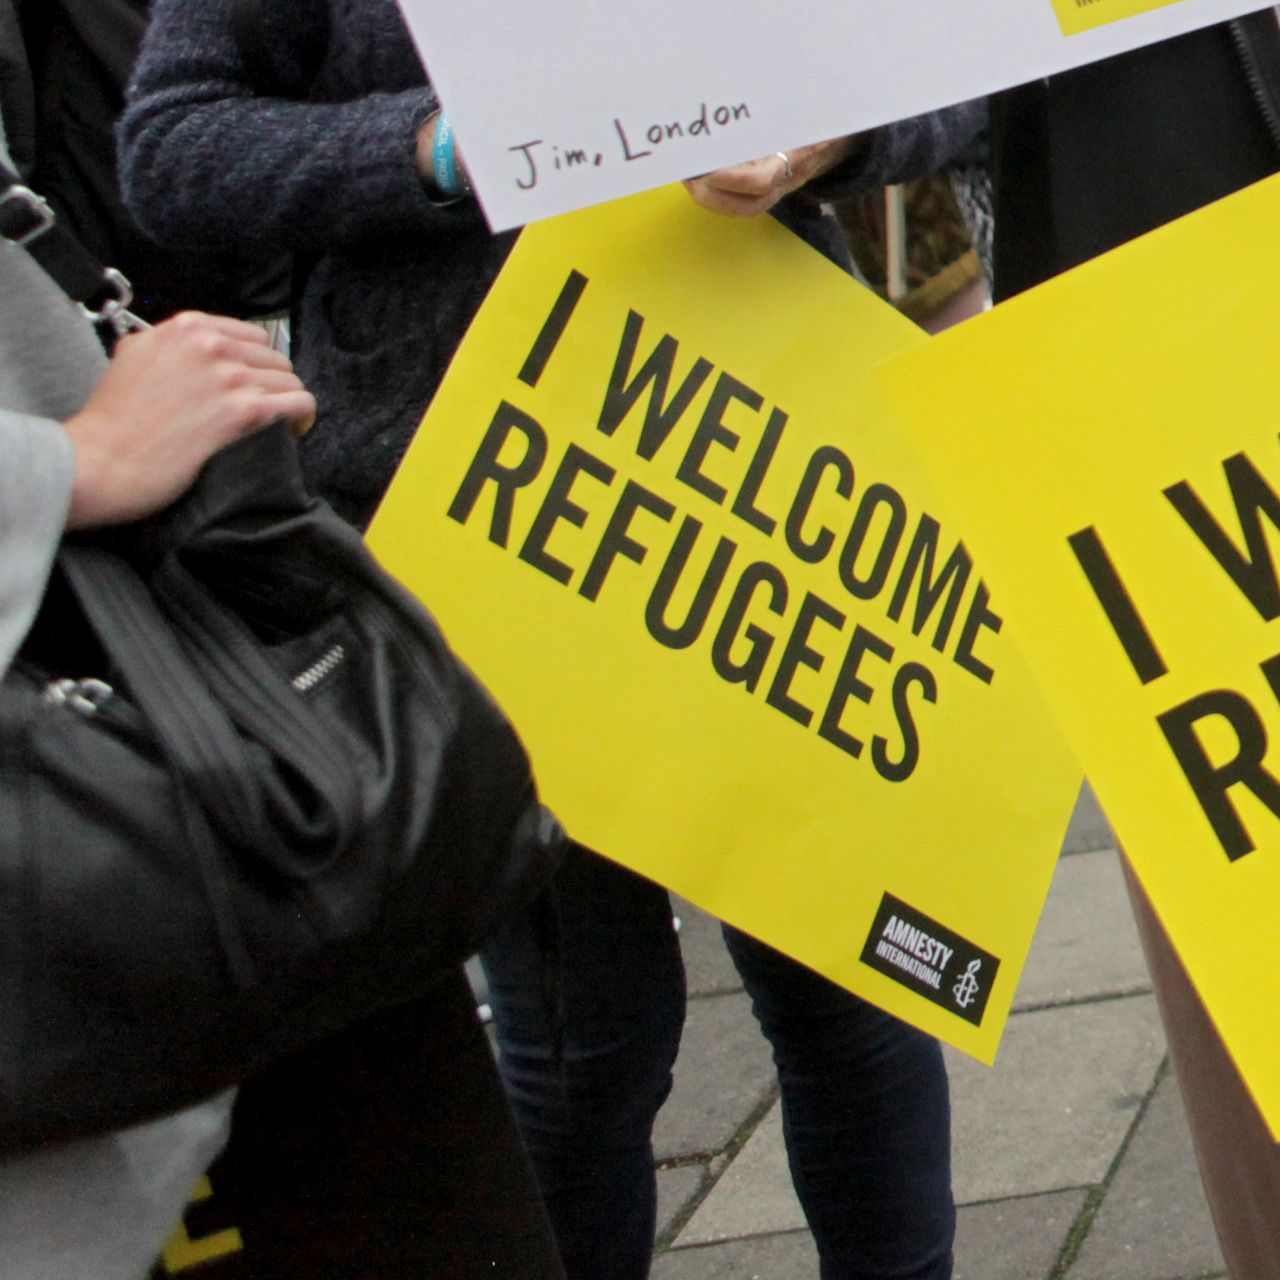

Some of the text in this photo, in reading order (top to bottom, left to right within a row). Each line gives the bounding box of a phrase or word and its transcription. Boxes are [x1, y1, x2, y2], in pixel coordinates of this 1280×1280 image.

[509, 140, 602, 190] Jim,
[614, 103, 751, 162] London
[517, 268, 1003, 685] I WELCOME
[446, 400, 937, 783] REFUGEES
[1067, 526, 1168, 685] I
[875, 940, 942, 990] INTERNATIONAL
[882, 914, 954, 971] AMNESTY
